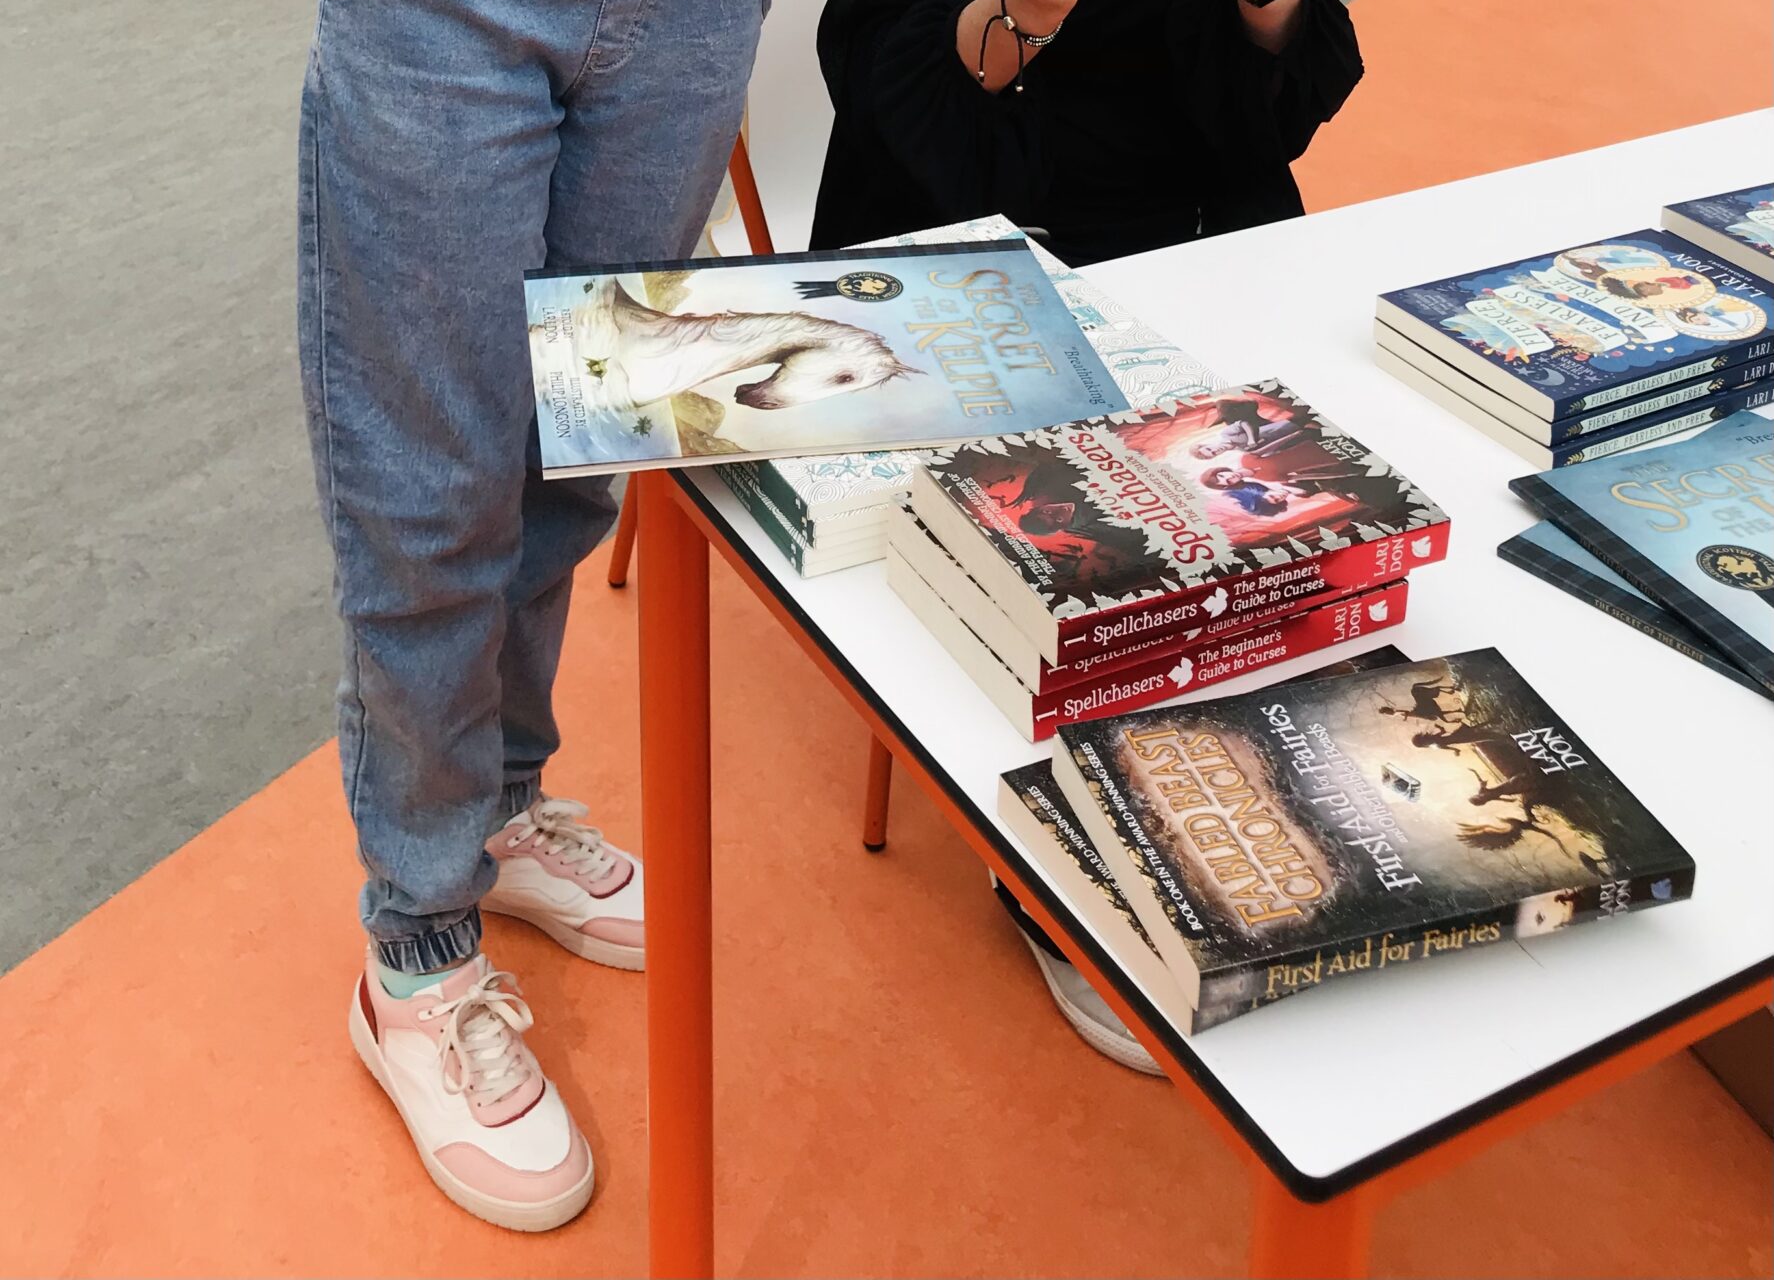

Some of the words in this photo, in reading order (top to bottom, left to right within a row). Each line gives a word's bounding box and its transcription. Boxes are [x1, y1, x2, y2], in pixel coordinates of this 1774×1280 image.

[1669, 254, 1714, 272] DON
[1547, 278, 1608, 304] FREE
[1712, 273, 1766, 298] LARI
[928, 268, 1058, 376] SECRET
[1475, 301, 1546, 346] FIERCE,
[1504, 290, 1620, 340] FEARLESS
[1615, 305, 1664, 330] AND
[545, 325, 559, 344] DON
[1748, 342, 1771, 358] LARI
[550, 370, 565, 396] PHILIP
[906, 318, 1015, 418] KELPIE
[1590, 390, 1622, 406] FIERCE,
[1625, 374, 1665, 396] FEARLESS
[1668, 370, 1685, 382] AND
[1686, 363, 1708, 378] FREE
[1744, 364, 1766, 381] LARI
[570, 376, 585, 418] ILLUSTRATED
[1588, 414, 1618, 430] FIERCE,
[1622, 397, 1662, 419] FEARLESS
[1664, 392, 1682, 405] AND
[1682, 385, 1704, 400] FREE
[1746, 391, 1768, 408] LARI
[553, 396, 571, 439] LONGSON
[575, 418, 587, 429] BY
[1590, 442, 1620, 457] FIERCE,
[1624, 426, 1662, 447] FEARLESS
[1666, 421, 1684, 433] AND
[1685, 413, 1706, 426] FREE
[1316, 440, 1352, 460] LARI
[1329, 436, 1366, 458] DON
[947, 471, 961, 484] OF
[956, 480, 984, 509] AUTHOR
[1156, 468, 1187, 495] Curses
[1068, 432, 1215, 564] Spellchasers
[977, 504, 1031, 562] AWARD-WINNING
[1184, 507, 1202, 526] The
[1015, 533, 1044, 561] FABLED
[1374, 540, 1390, 577] LARI
[1390, 536, 1405, 572] DON
[1024, 558, 1043, 575] THE
[1036, 573, 1052, 587] BY
[1037, 558, 1056, 576] THE
[1233, 581, 1254, 596] The
[1257, 562, 1321, 592] Beginner's
[1232, 592, 1268, 612] Guide
[1270, 590, 1282, 602] to
[1283, 578, 1326, 599] Curses
[1093, 602, 1198, 646] Spellchasers
[1334, 606, 1348, 642] LARI
[1348, 602, 1362, 638] DON
[1594, 598, 1610, 612] THE
[1610, 606, 1642, 630] SECRET
[1643, 625, 1656, 636] OF
[1657, 632, 1674, 647] THE
[1676, 642, 1704, 662] KELPIE
[1198, 650, 1220, 666] The
[1222, 630, 1282, 661] Beginner's
[1198, 662, 1232, 682] Guide
[1232, 656, 1246, 669] to
[1246, 644, 1286, 666] Curses
[1064, 674, 1164, 720] Spellchasers
[1080, 742, 1103, 770] SERIES
[1260, 703, 1328, 778] Fairies
[1304, 720, 1343, 763] Beasts
[1510, 730, 1567, 776] LARI
[1530, 726, 1589, 770] DON
[1124, 728, 1210, 814] BEAST
[1314, 770, 1338, 794] for
[1332, 756, 1374, 799] Fabled
[1027, 785, 1054, 812] SERIES
[1095, 767, 1151, 849] AWARD-WINNING
[1310, 780, 1372, 834] Aid
[1360, 792, 1398, 832] Other
[1180, 732, 1323, 902] CHRONICLES
[1046, 807, 1115, 882] AWARD-WINNING
[1387, 824, 1409, 848] and
[1143, 845, 1163, 867] THE
[1155, 864, 1171, 881] IN
[1184, 812, 1303, 929] FABLED
[1344, 835, 1424, 892] First
[1163, 877, 1185, 902] ONE
[1176, 899, 1204, 933] BOOK
[1265, 950, 1324, 993] First
[1326, 936, 1374, 976] Aid
[1378, 932, 1416, 968] for
[1422, 921, 1501, 958] Fairies
